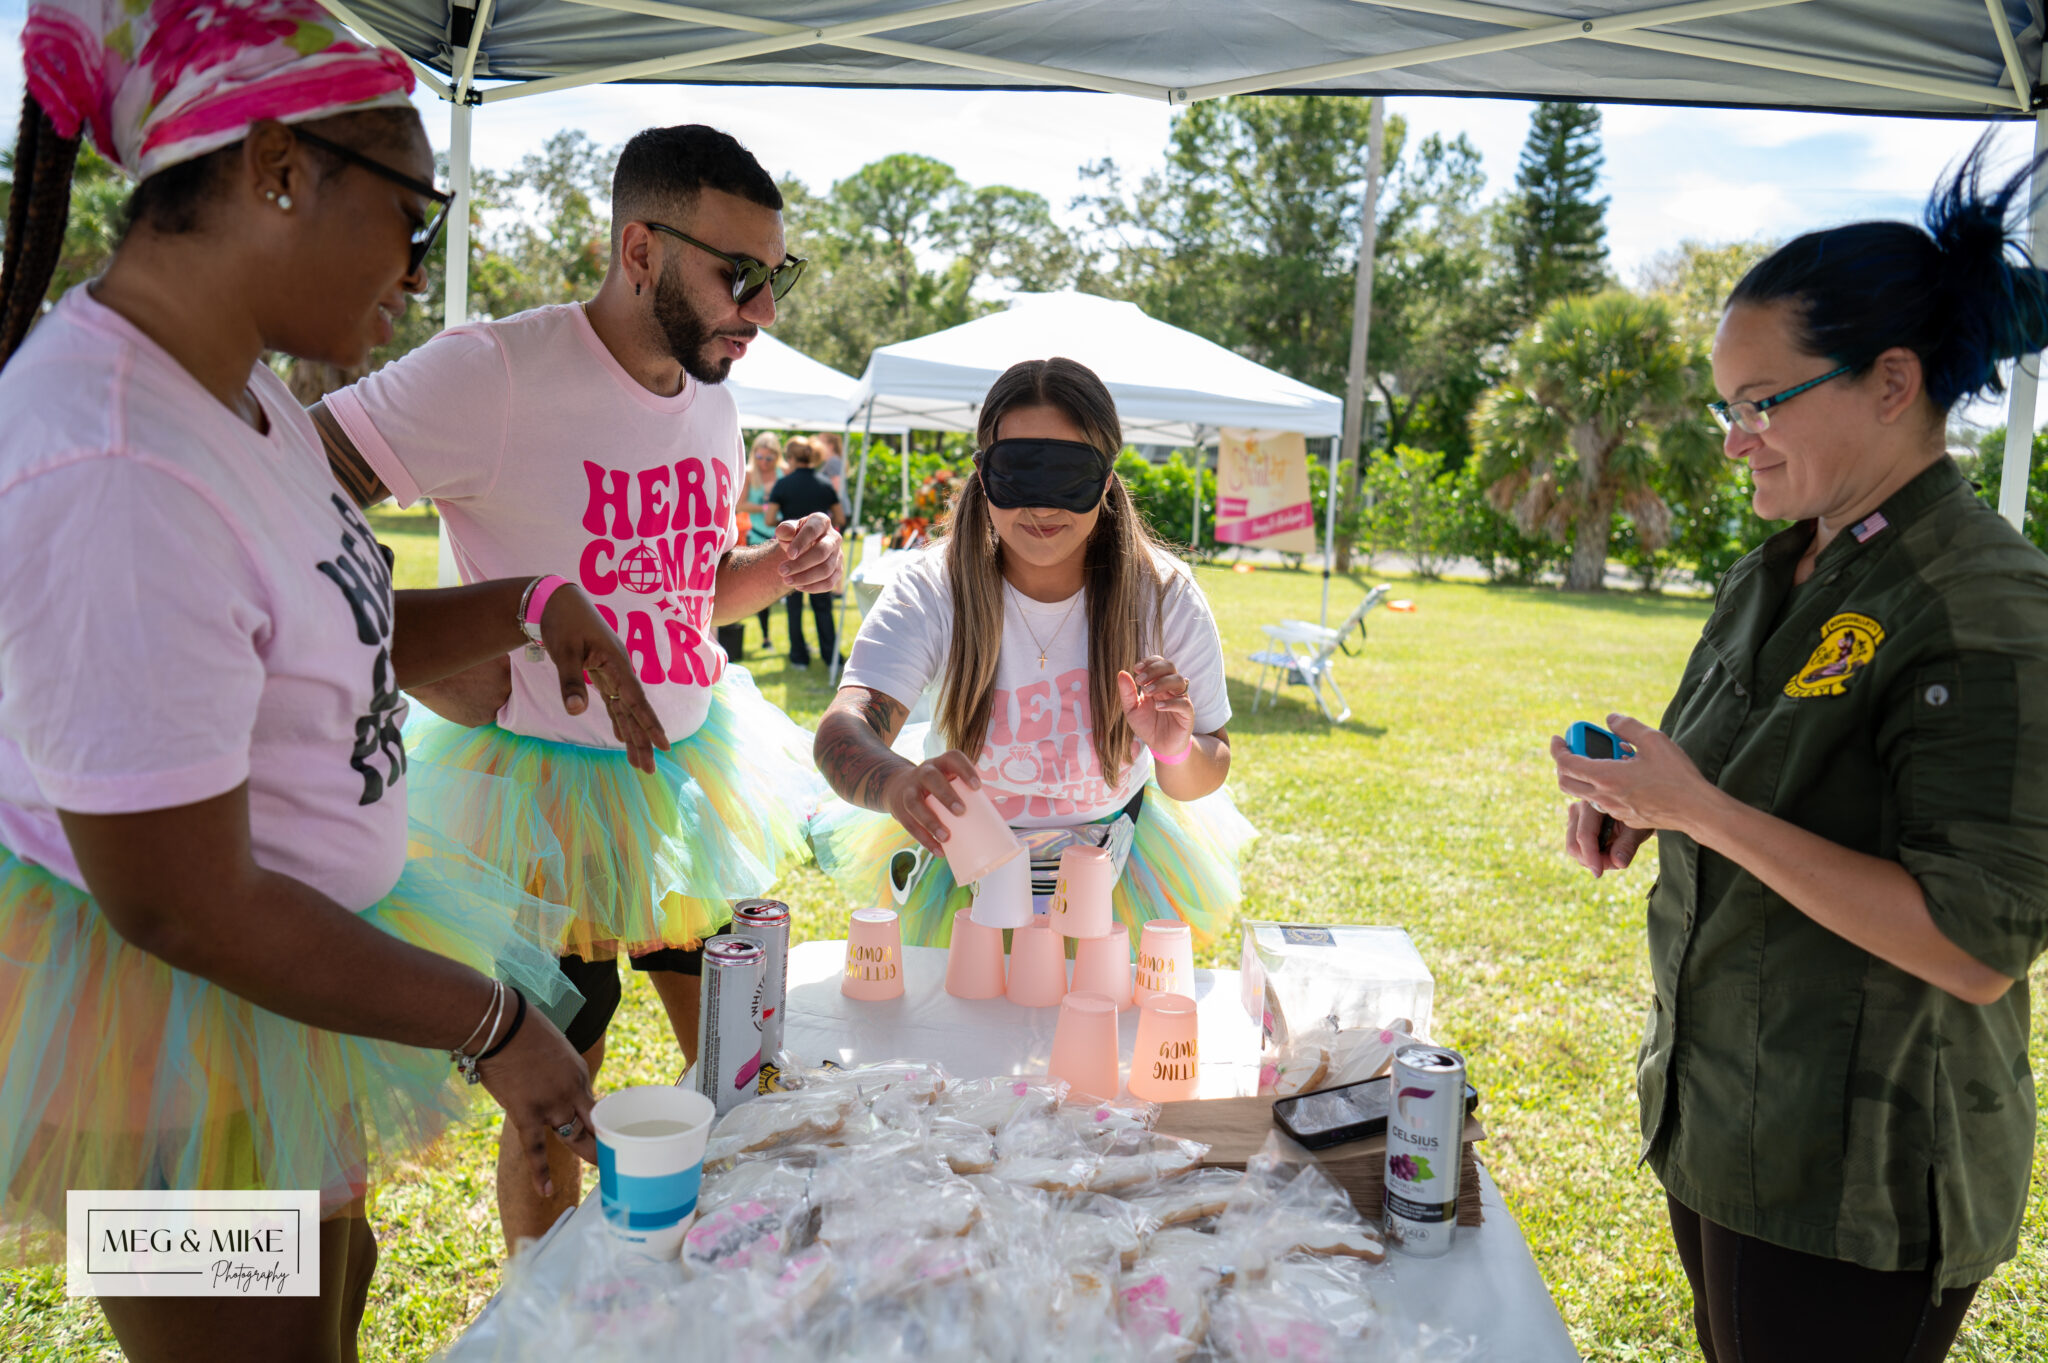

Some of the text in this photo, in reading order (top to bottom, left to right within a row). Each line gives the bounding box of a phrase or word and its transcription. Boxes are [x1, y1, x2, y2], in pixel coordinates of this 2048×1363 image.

[582, 456, 732, 541] HERE
[580, 529, 724, 596] COME
[988, 667, 1097, 747] HER
[751, 971, 766, 1018] WHIT
[1160, 1039, 1197, 1060] OWDY
[1391, 1125, 1440, 1147] CELSIUS
